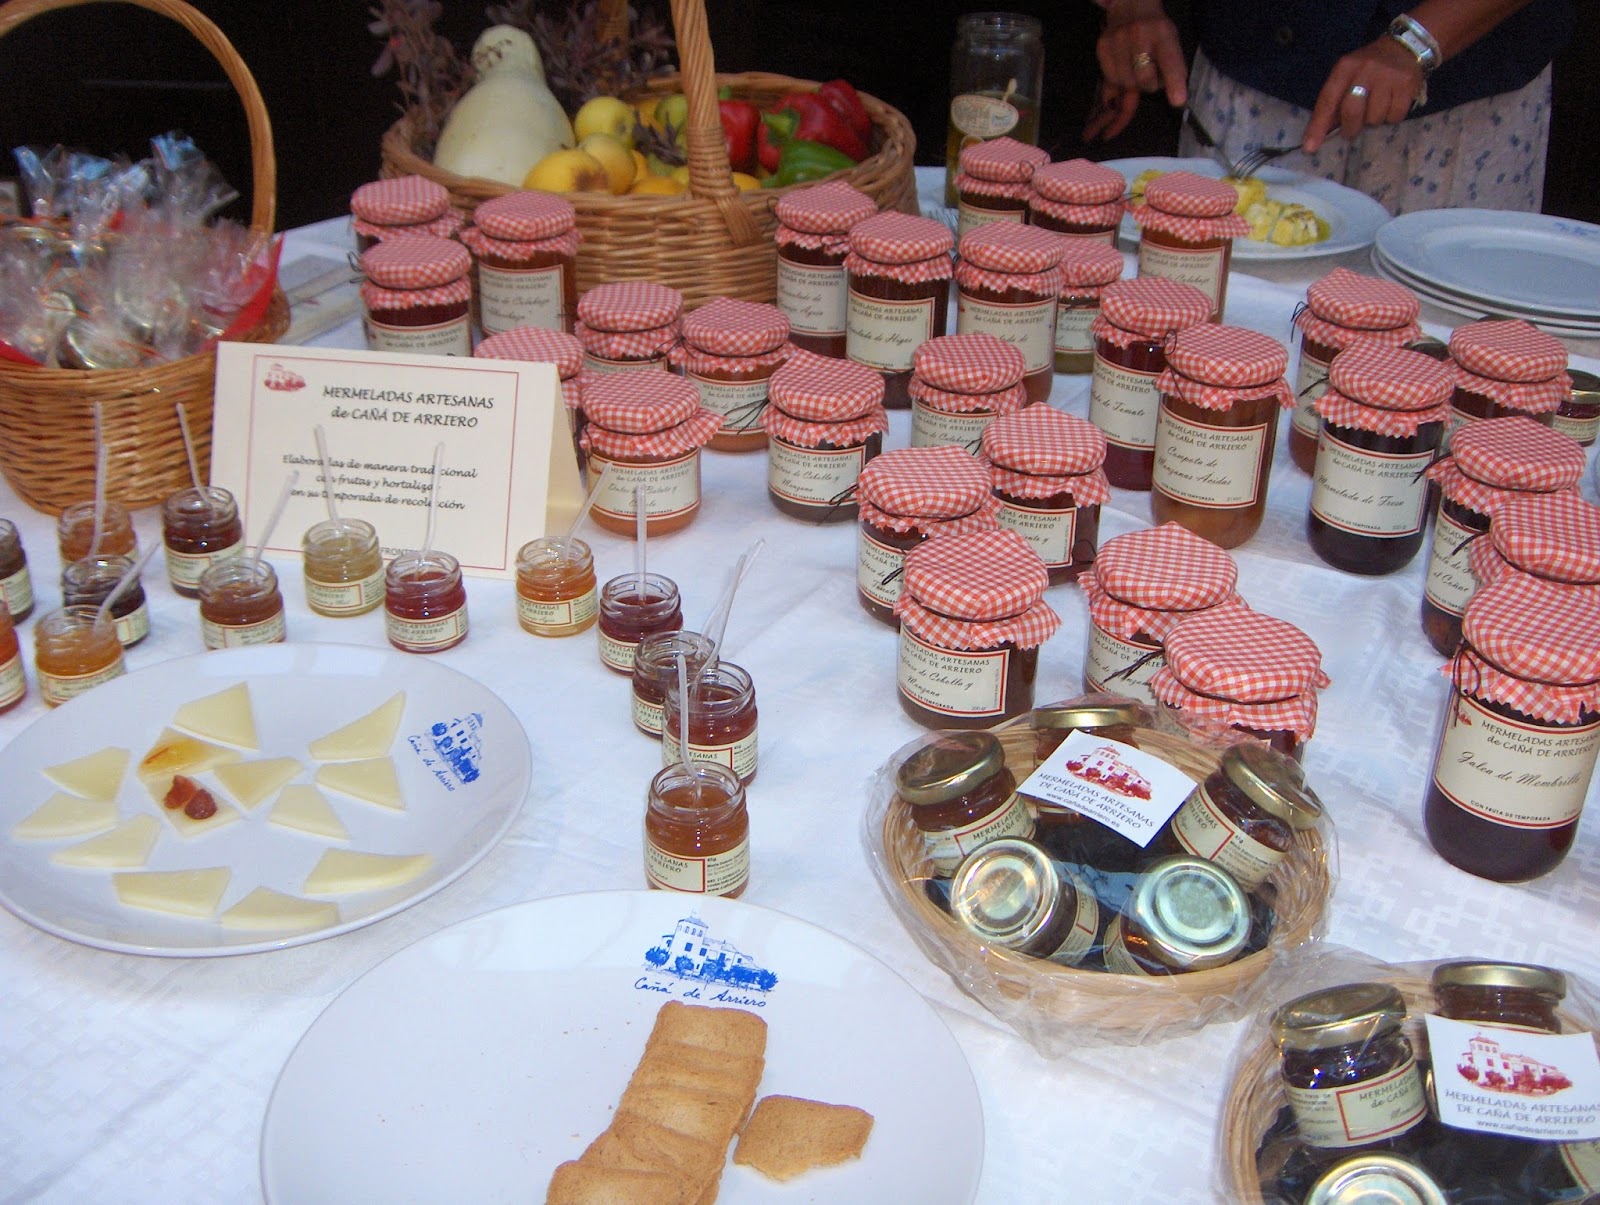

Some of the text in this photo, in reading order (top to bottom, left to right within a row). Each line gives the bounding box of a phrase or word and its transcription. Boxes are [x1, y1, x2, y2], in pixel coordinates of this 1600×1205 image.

[322, 385, 495, 409] MERMELADAS ARTESANAS
[1116, 382, 1151, 394] ARRIERO
[331, 406, 348, 419] de
[392, 411, 411, 424] DE
[413, 413, 479, 428] ARRIERO
[1113, 401, 1146, 417] Tomate
[1164, 418, 1208, 440] MERMELADAS
[1209, 434, 1254, 443] ARTESANAS
[1196, 440, 1207, 448] DE
[1208, 443, 1248, 451] ARRIERO
[282, 454, 479, 479] Elaboraas de manera tradcional
[812, 454, 853, 462] ARTESANAS
[813, 462, 847, 470] ARRIERO
[1167, 445, 1218, 468] Compota de
[1328, 444, 1423, 470] MERMELADAS ARTESANAS
[1157, 455, 1194, 480] Manzanas
[1364, 468, 1377, 477] DE
[337, 473, 372, 487] frutas
[372, 478, 381, 489] y
[381, 477, 442, 493] hortaliza
[1318, 474, 1374, 505] Mermelada de
[290, 489, 306, 497] en
[307, 490, 320, 499] su
[384, 494, 400, 505] de
[401, 497, 466, 510] recoleción
[1007, 517, 1055, 530] DE ARRIERO
[1018, 513, 1062, 522] ARTESANAS
[929, 660, 939, 669] DE
[941, 665, 983, 674] ARRIERO
[940, 656, 990, 666] ARTESANAS
[1120, 653, 1130, 661] DE
[906, 675, 941, 698] Manzana
[928, 672, 964, 687] Cebolla
[964, 681, 974, 691] y
[1481, 719, 1553, 747] MERMELADAS
[1487, 735, 1501, 746] de
[1536, 748, 1551, 757] DE
[1553, 743, 1594, 758] ARRIERO
[1496, 770, 1513, 782] de
[1038, 773, 1155, 828] MERMELADAS ARTESANAS
[1039, 781, 1052, 790] DE
[1081, 795, 1095, 805] DE
[1096, 802, 1142, 829] ARRIERO
[1470, 799, 1551, 822] CON FRUTA DE TEMPORADA
[683, 988, 701, 1000] de
[709, 989, 767, 1008] Arriero
[1371, 1099, 1386, 1109] de
[1445, 1088, 1528, 1111] MERMELADAS
[1456, 1103, 1471, 1114] DE
[1514, 1112, 1530, 1122] DE
[1534, 1114, 1597, 1125] ARRIERO
